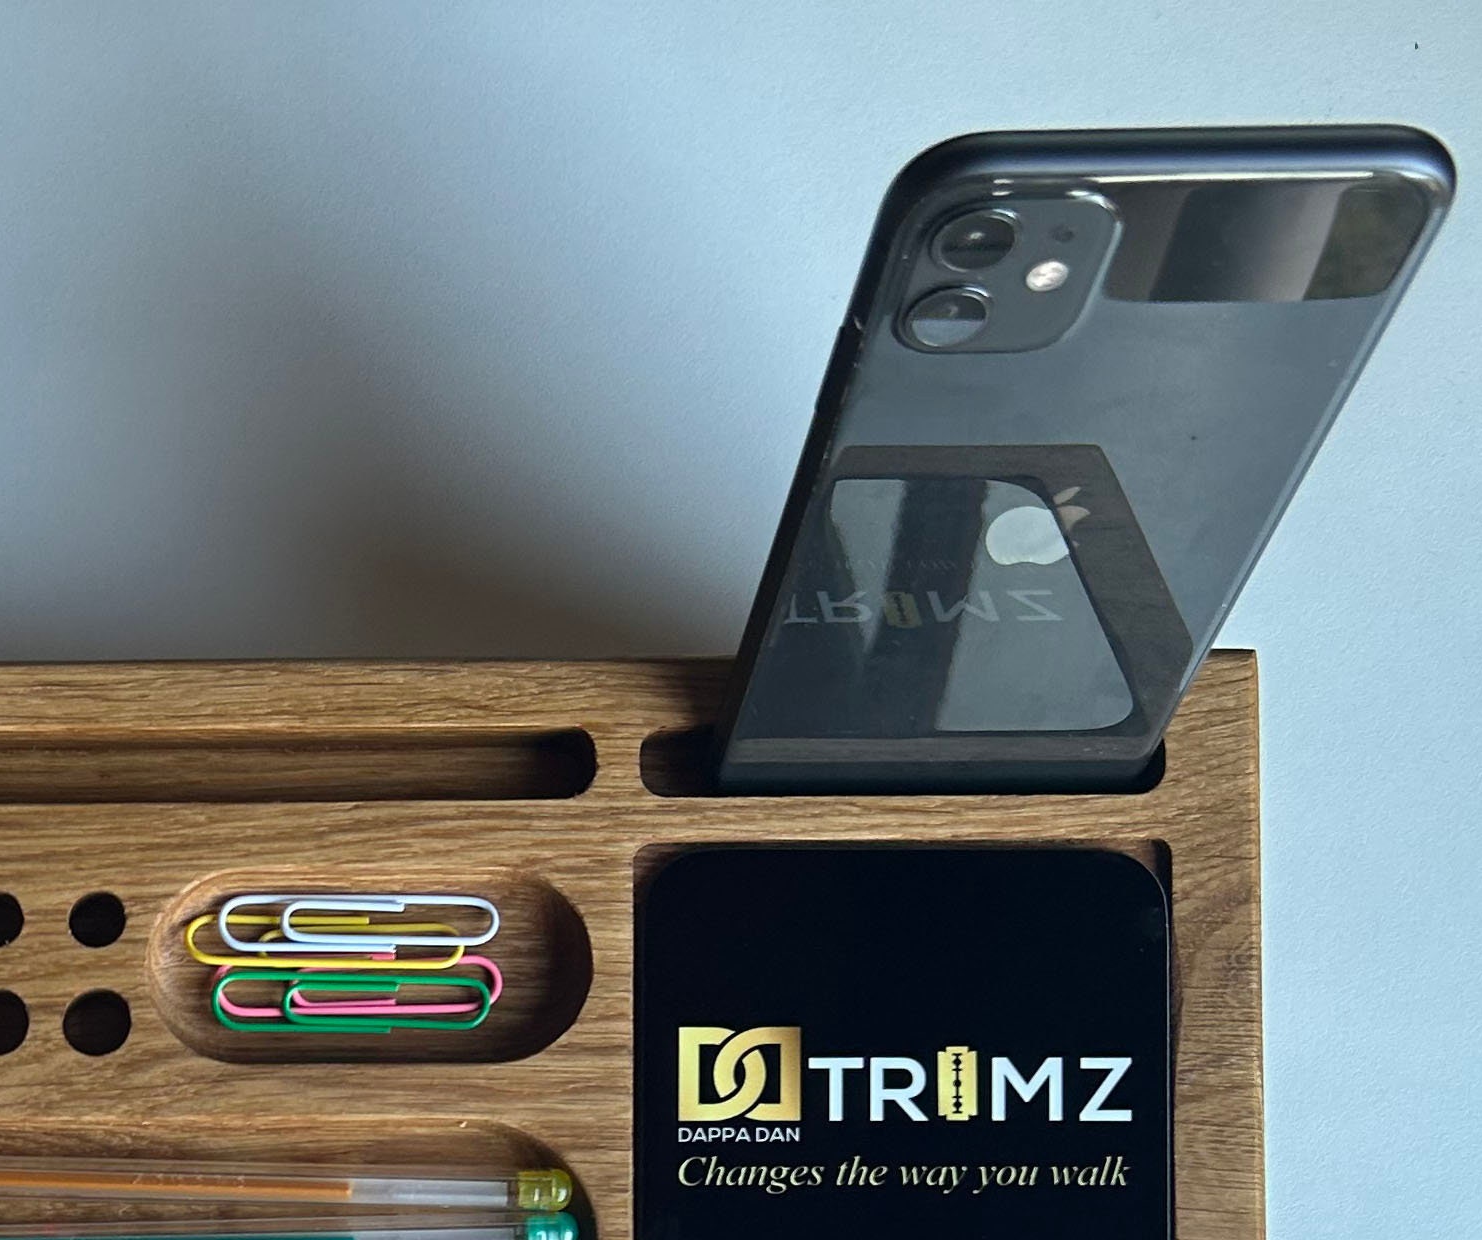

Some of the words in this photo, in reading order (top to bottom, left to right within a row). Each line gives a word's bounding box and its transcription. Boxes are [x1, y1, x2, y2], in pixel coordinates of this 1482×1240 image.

[677, 1126, 752, 1143] DAPPA
[755, 1126, 801, 1143] DAN
[677, 1154, 825, 1195] Changes
[835, 1154, 889, 1187] the
[898, 1165, 968, 1195] way
[971, 1165, 1039, 1195] you
[1049, 1155, 1131, 1187] walk
